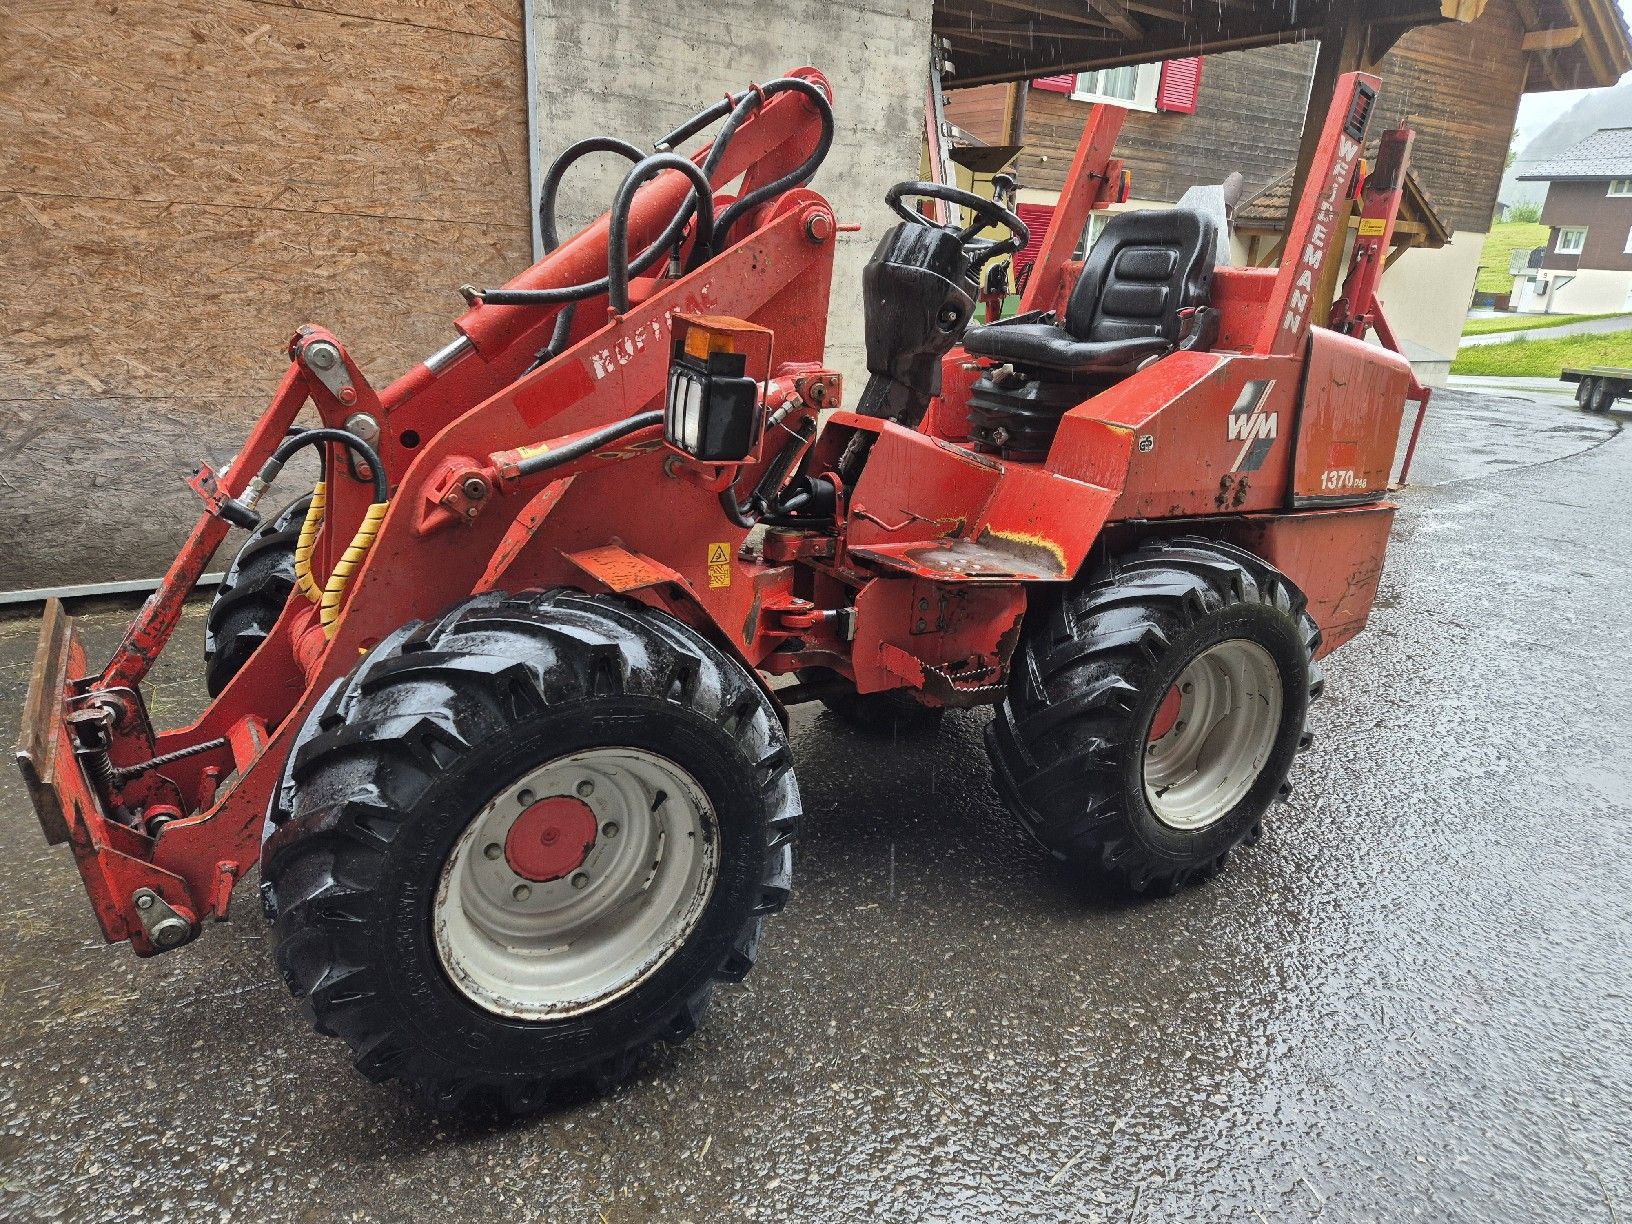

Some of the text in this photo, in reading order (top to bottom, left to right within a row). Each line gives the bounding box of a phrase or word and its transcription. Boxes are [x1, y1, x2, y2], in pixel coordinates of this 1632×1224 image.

[1283, 134, 1359, 334] WEIDEMANN
[1227, 411, 1278, 442] WM
[1321, 470, 1354, 490] 1370
